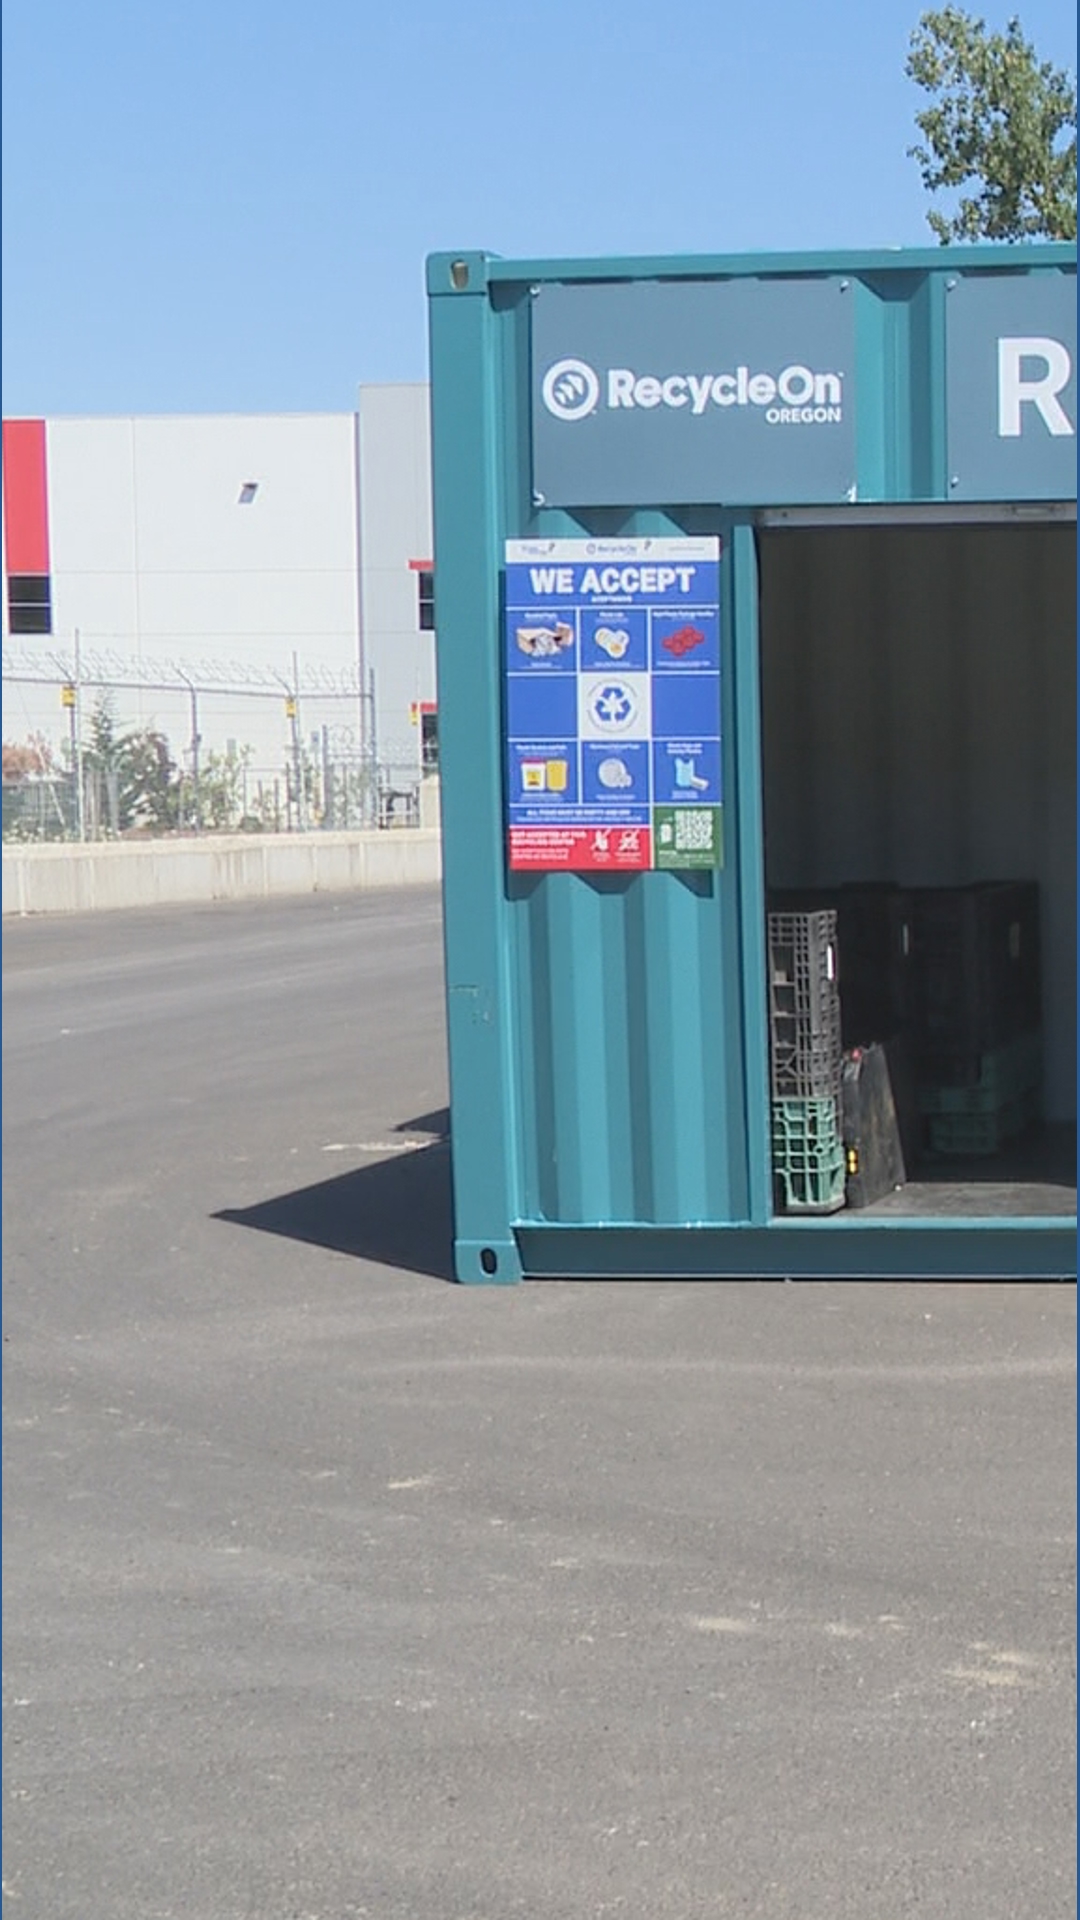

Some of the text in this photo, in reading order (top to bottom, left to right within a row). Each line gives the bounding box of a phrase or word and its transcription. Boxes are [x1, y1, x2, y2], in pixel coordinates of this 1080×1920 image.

[608, 365, 841, 414] RecycleOn
[998, 337, 1075, 436] R
[765, 407, 842, 424] OREGON
[530, 566, 696, 594] WE ACCEPT
